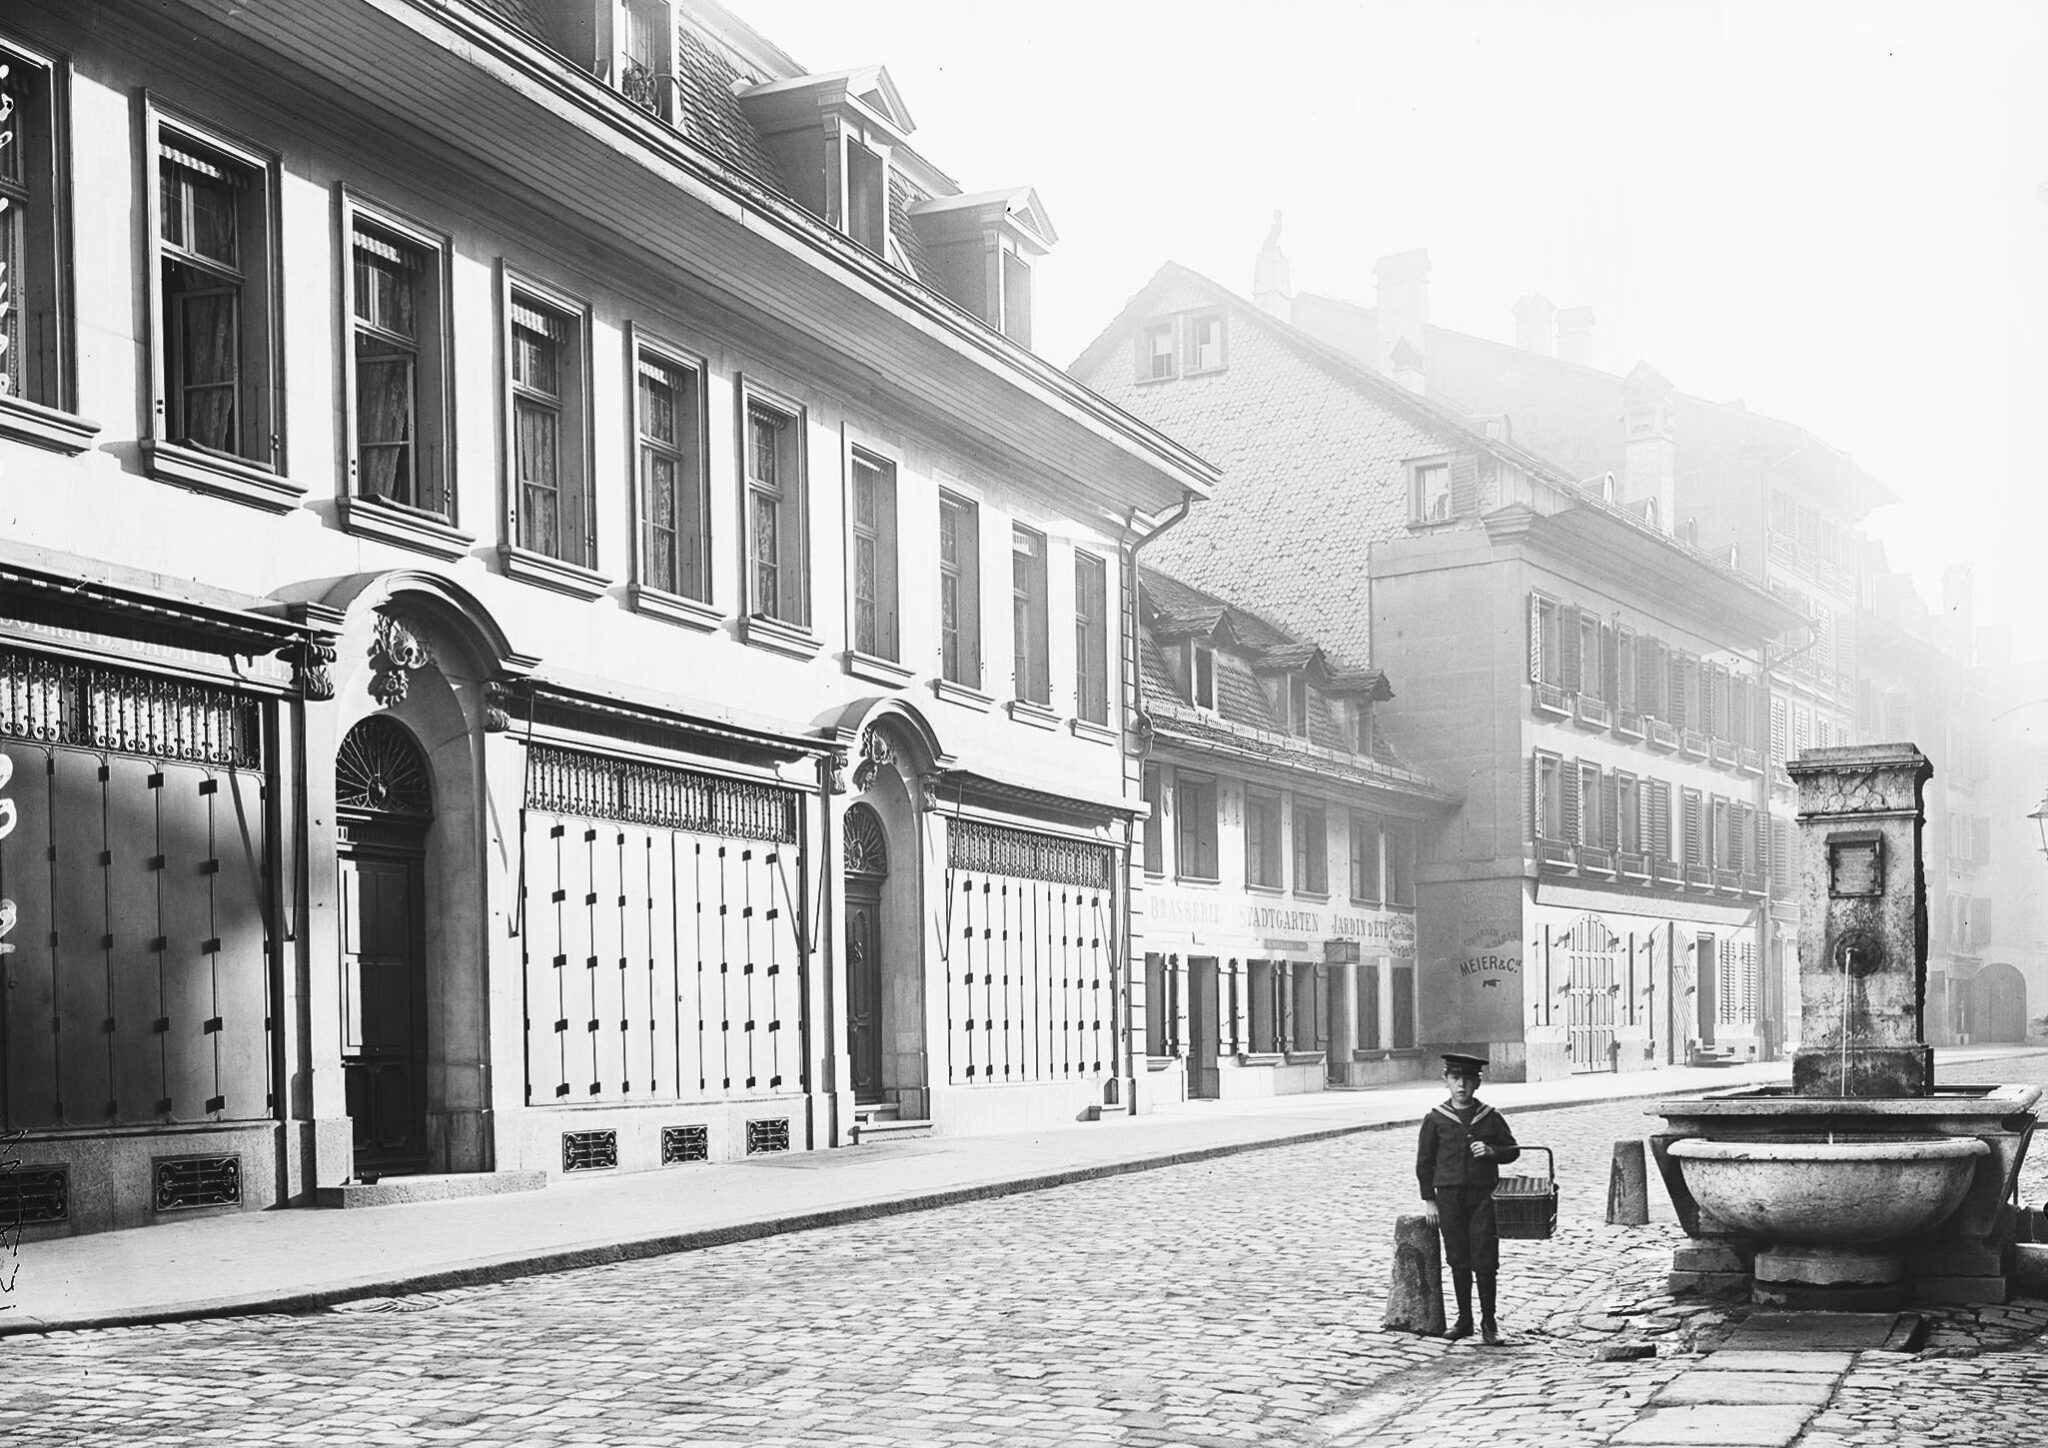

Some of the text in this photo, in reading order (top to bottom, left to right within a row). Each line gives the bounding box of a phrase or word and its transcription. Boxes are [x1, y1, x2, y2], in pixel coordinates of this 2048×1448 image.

[1150, 896, 1222, 924] BRASSERIE
[1240, 906, 1319, 932] STADTGARTEN
[1331, 914, 1367, 937] JARDIN
